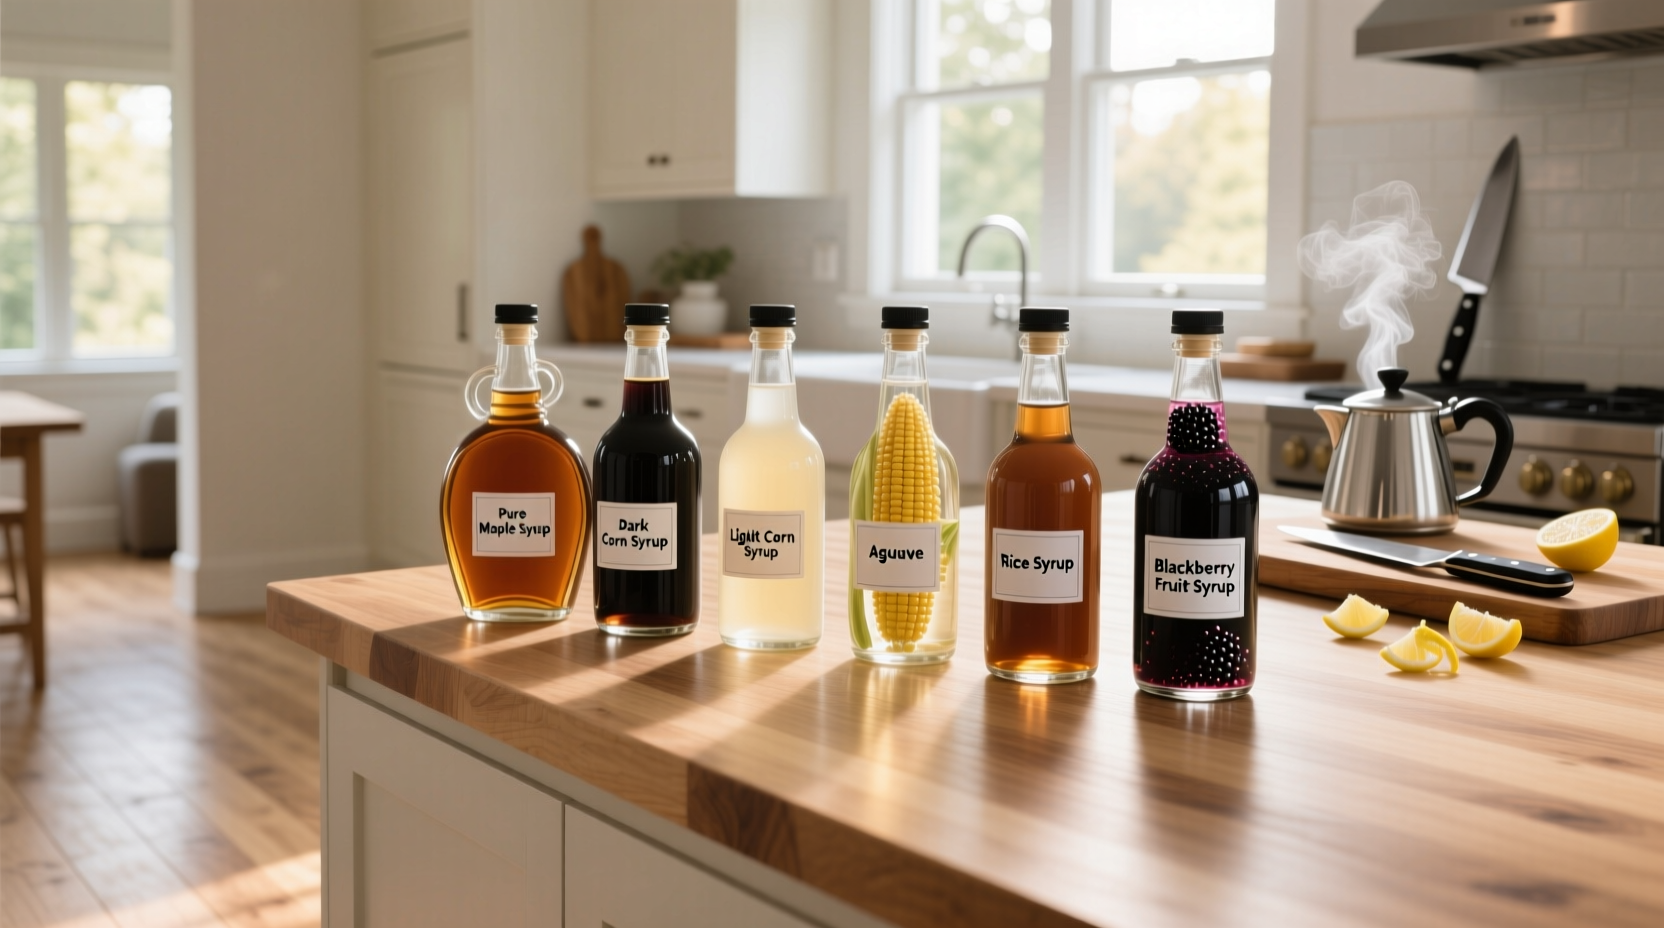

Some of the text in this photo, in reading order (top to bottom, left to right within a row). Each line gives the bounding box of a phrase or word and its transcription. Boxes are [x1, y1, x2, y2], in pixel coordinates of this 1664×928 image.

[499, 507, 526, 519] Pure
[480, 522, 516, 537] Maple
[619, 518, 648, 531] Dark
[602, 533, 668, 550] Corn Syrup
[764, 530, 794, 543] Corn
[744, 546, 778, 561] Syrup
[1001, 553, 1074, 574] Rice Syrup
[1155, 558, 1235, 577] Blackberry
[1155, 577, 1235, 597] Fruit Syrup
